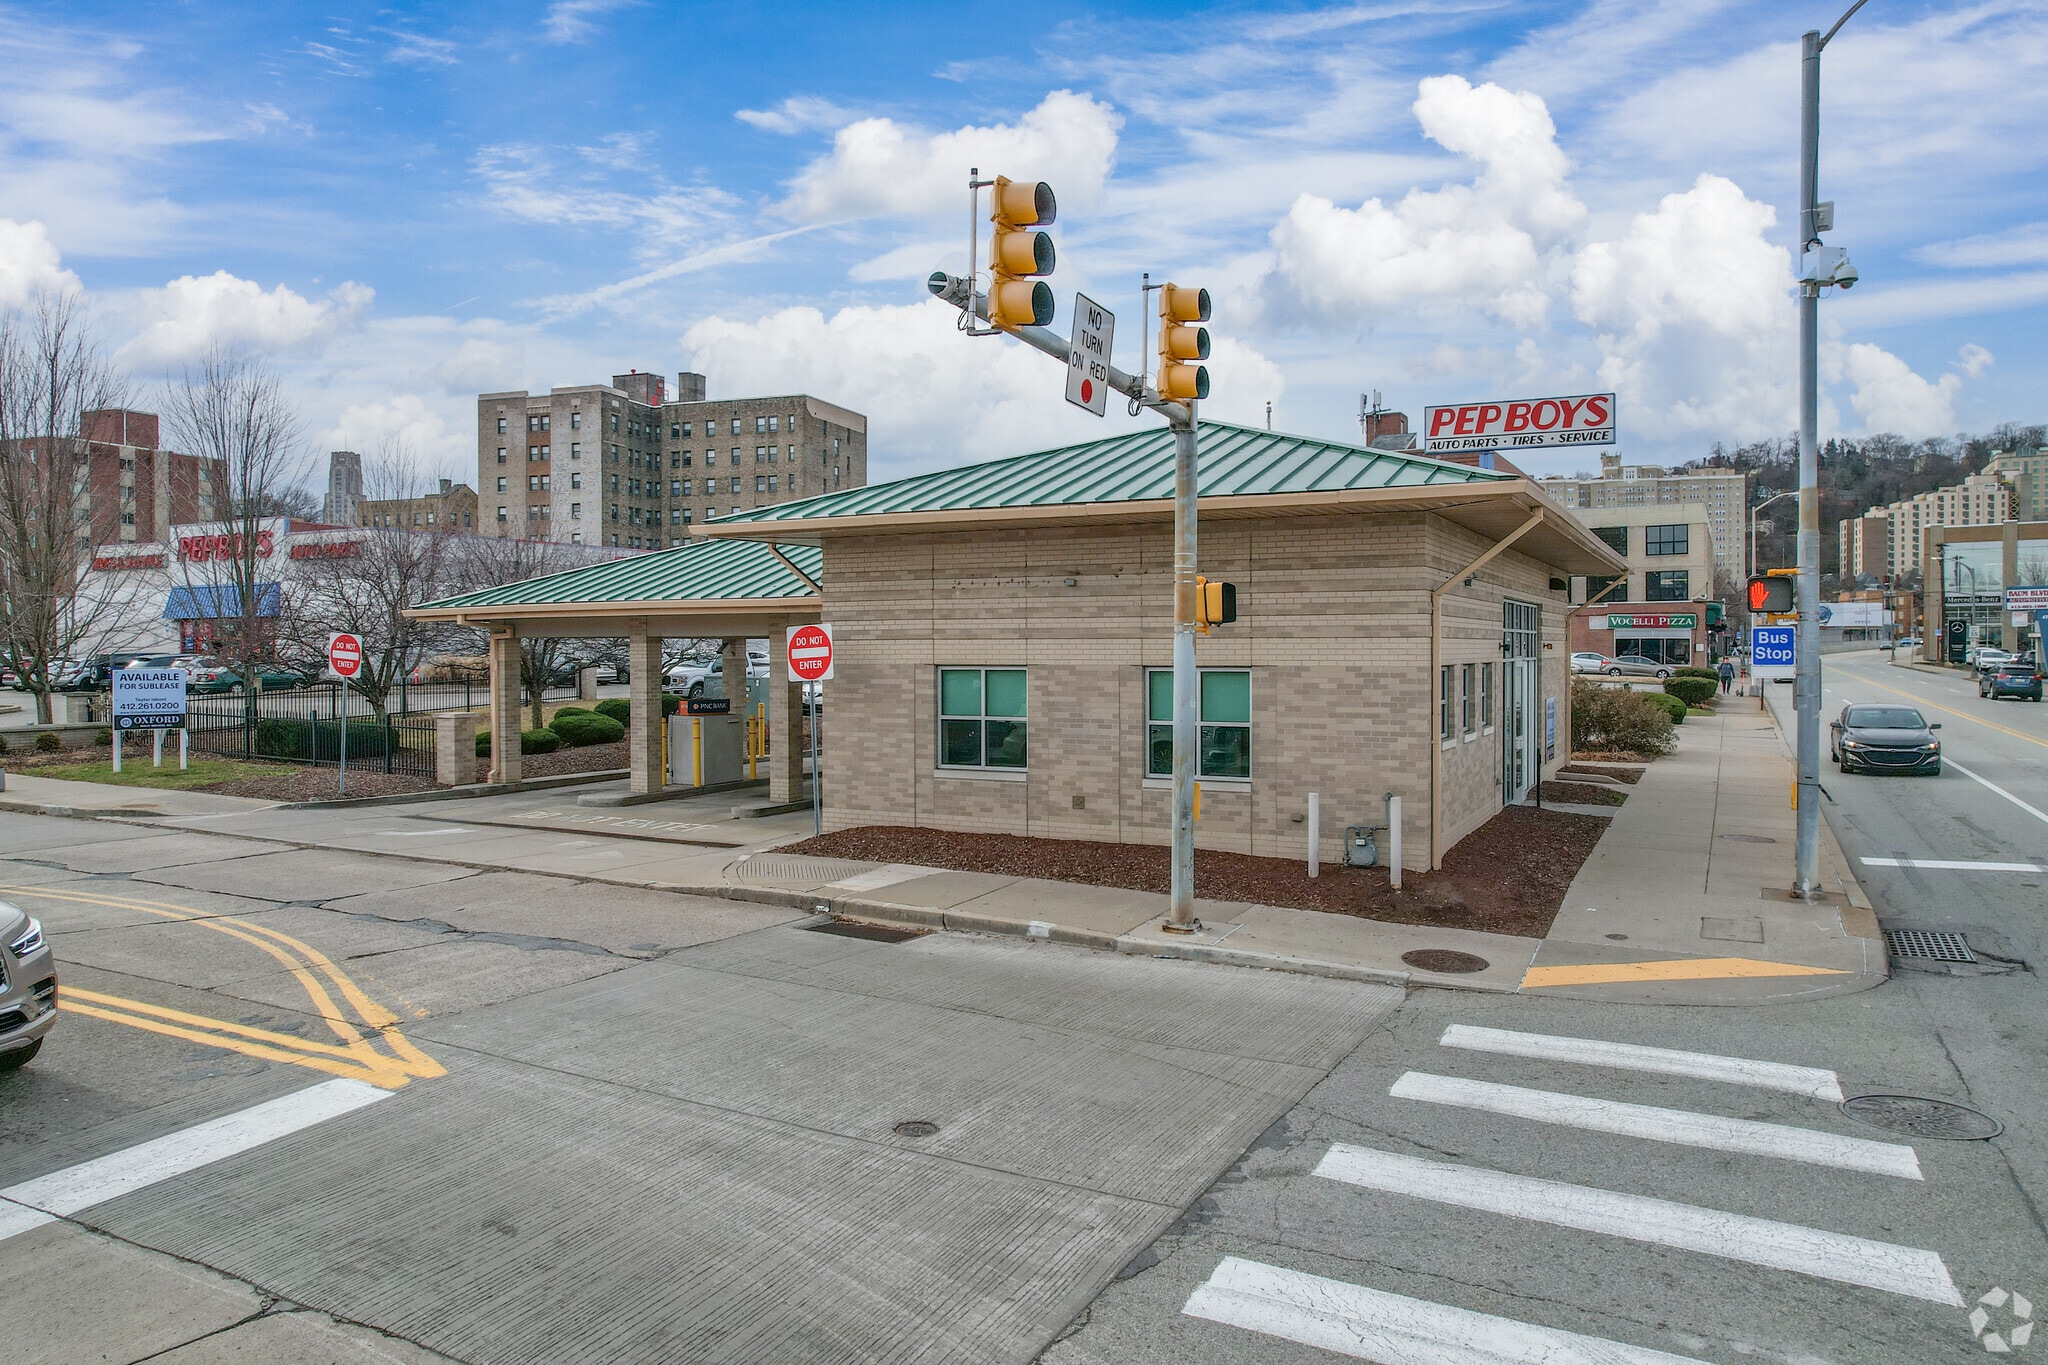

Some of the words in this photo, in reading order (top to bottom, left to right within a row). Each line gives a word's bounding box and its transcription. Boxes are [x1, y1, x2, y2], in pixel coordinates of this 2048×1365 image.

[1088, 307, 1102, 331] NO
[1082, 329, 1103, 356] TURN
[1072, 351, 1084, 371] ON
[1089, 361, 1107, 381] RED
[1429, 405, 1501, 437] PEP
[1504, 396, 1609, 432] BOYS
[1429, 440, 1460, 451] AUTO
[1462, 437, 1499, 448] PARTS
[1512, 435, 1544, 446] TIRES
[1559, 430, 1610, 443] SERVICE
[215, 530, 274, 560] BOS
[1610, 616, 1654, 626] VOCELLI
[1658, 616, 1692, 626] PIZZA
[796, 637, 806, 646] DO
[809, 635, 823, 645] NOT
[1758, 631, 1789, 644] Bus
[1755, 646, 1792, 662] Stop
[337, 660, 354, 669] ENTER
[799, 660, 822, 670] ENTER
[120, 673, 179, 681] AVAILABLE
[120, 702, 179, 710] 412.261.0200
[133, 716, 180, 725] OXFORD
